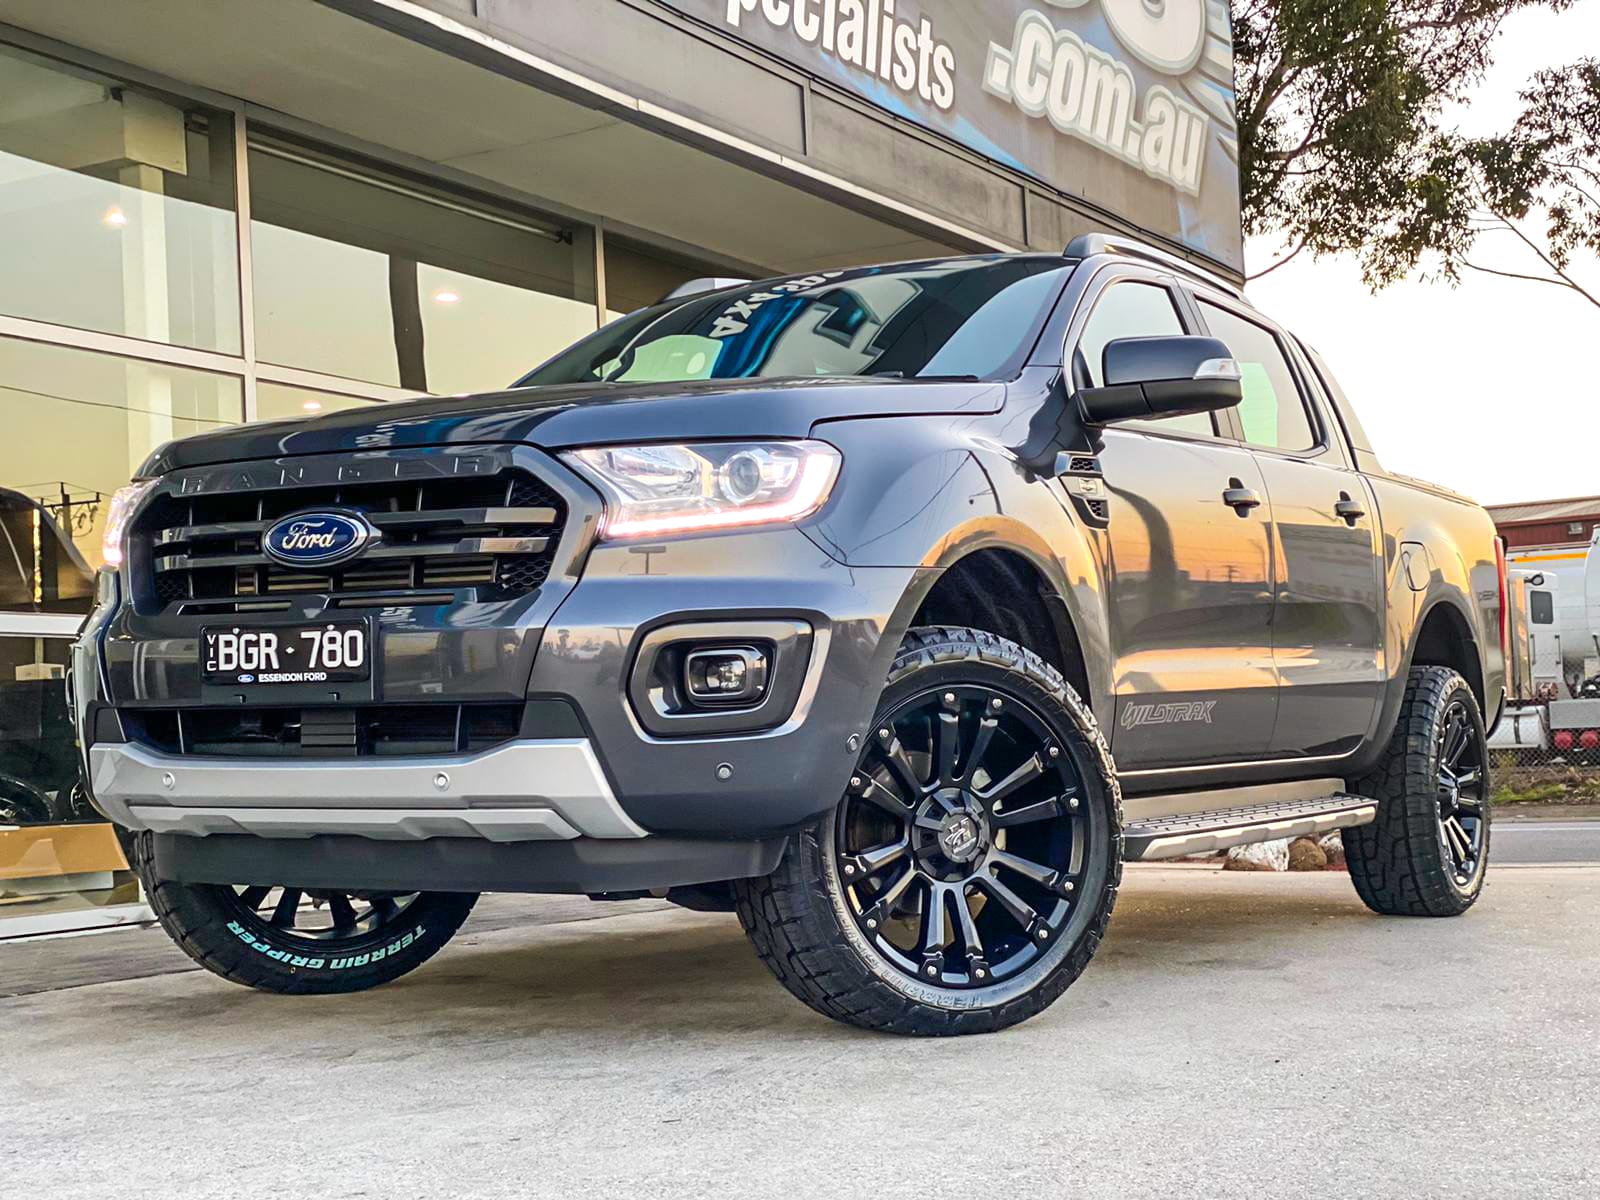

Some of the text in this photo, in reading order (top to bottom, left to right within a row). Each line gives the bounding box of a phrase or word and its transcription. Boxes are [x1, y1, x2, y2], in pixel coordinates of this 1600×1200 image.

[991, 21, 1203, 186] .com.au
[282, 521, 337, 549] Ford
[206, 634, 217, 671] VIC
[218, 629, 364, 671] BGR 780
[258, 673, 303, 683] ESSENDON
[303, 672, 327, 681] FORD
[1120, 700, 1217, 730] WILDTRAK
[226, 919, 426, 970] TERRAIN GRIPPER
